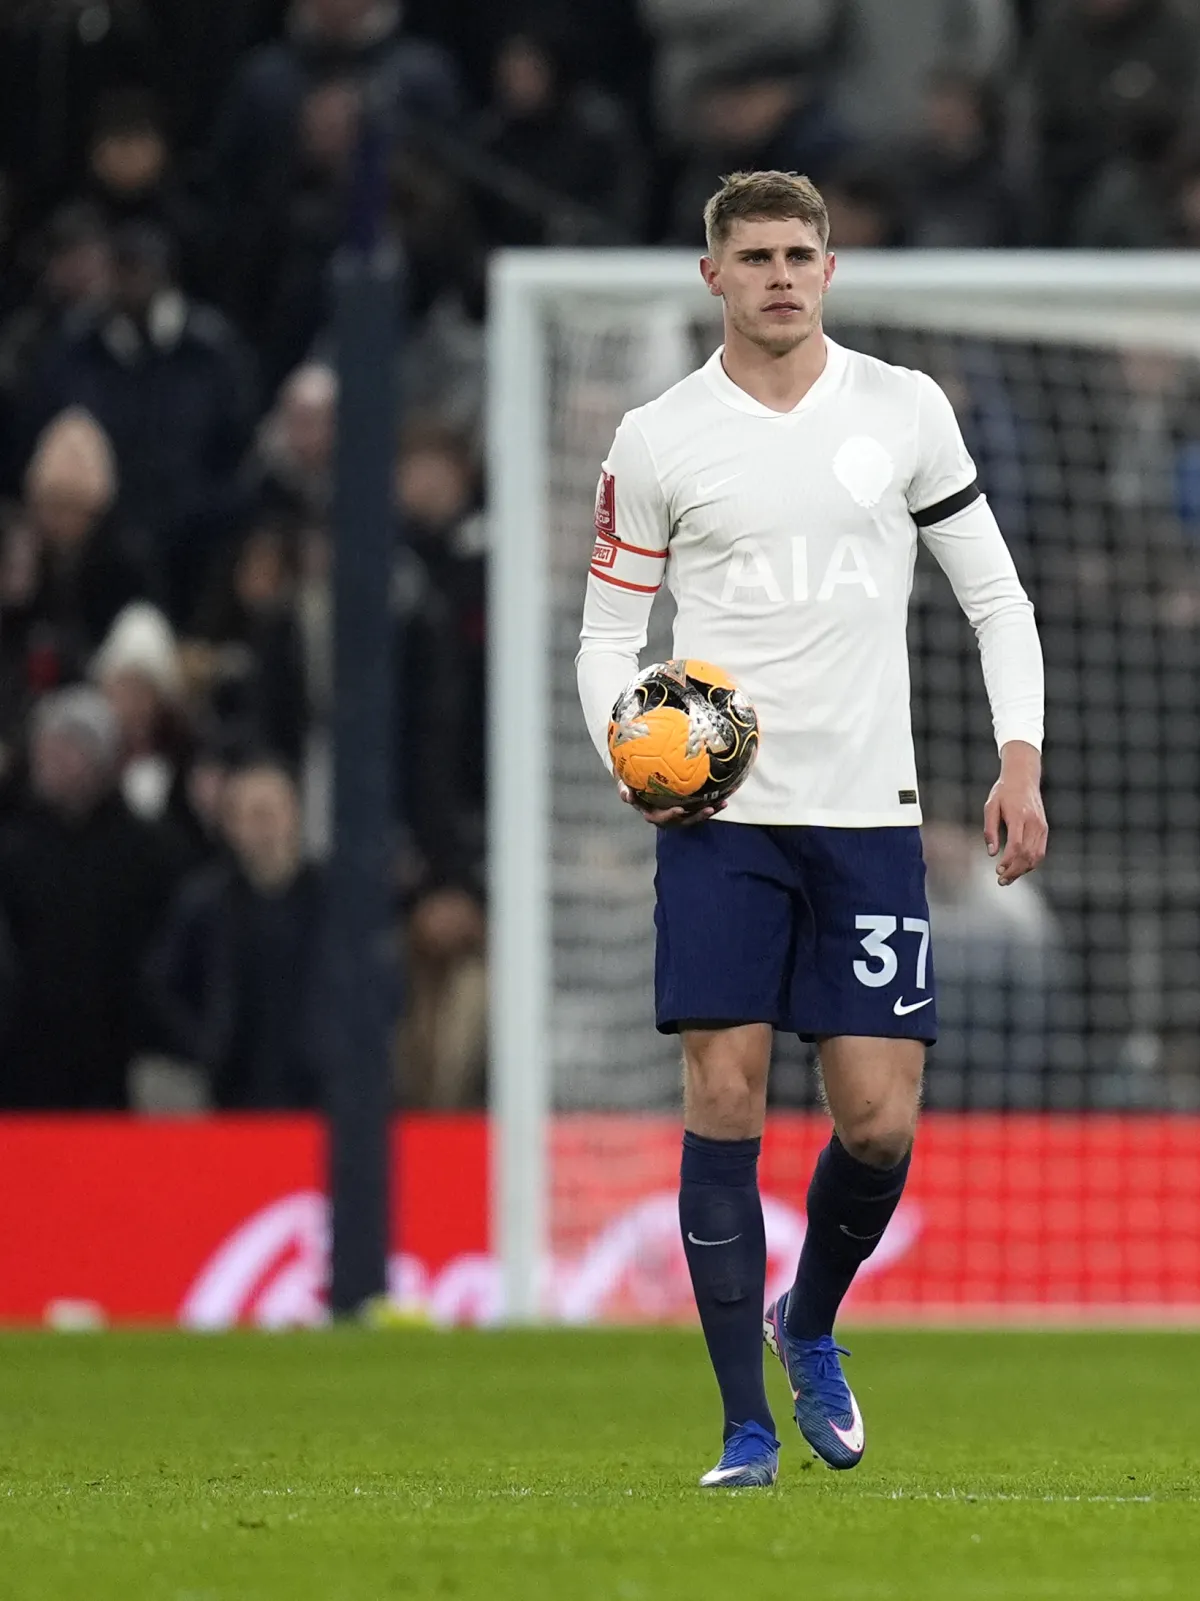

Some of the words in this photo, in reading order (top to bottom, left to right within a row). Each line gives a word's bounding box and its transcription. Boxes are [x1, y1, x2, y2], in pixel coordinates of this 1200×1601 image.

[593, 548, 610, 560] PECT
[722, 534, 879, 603] AIA
[852, 914, 930, 989] 37
